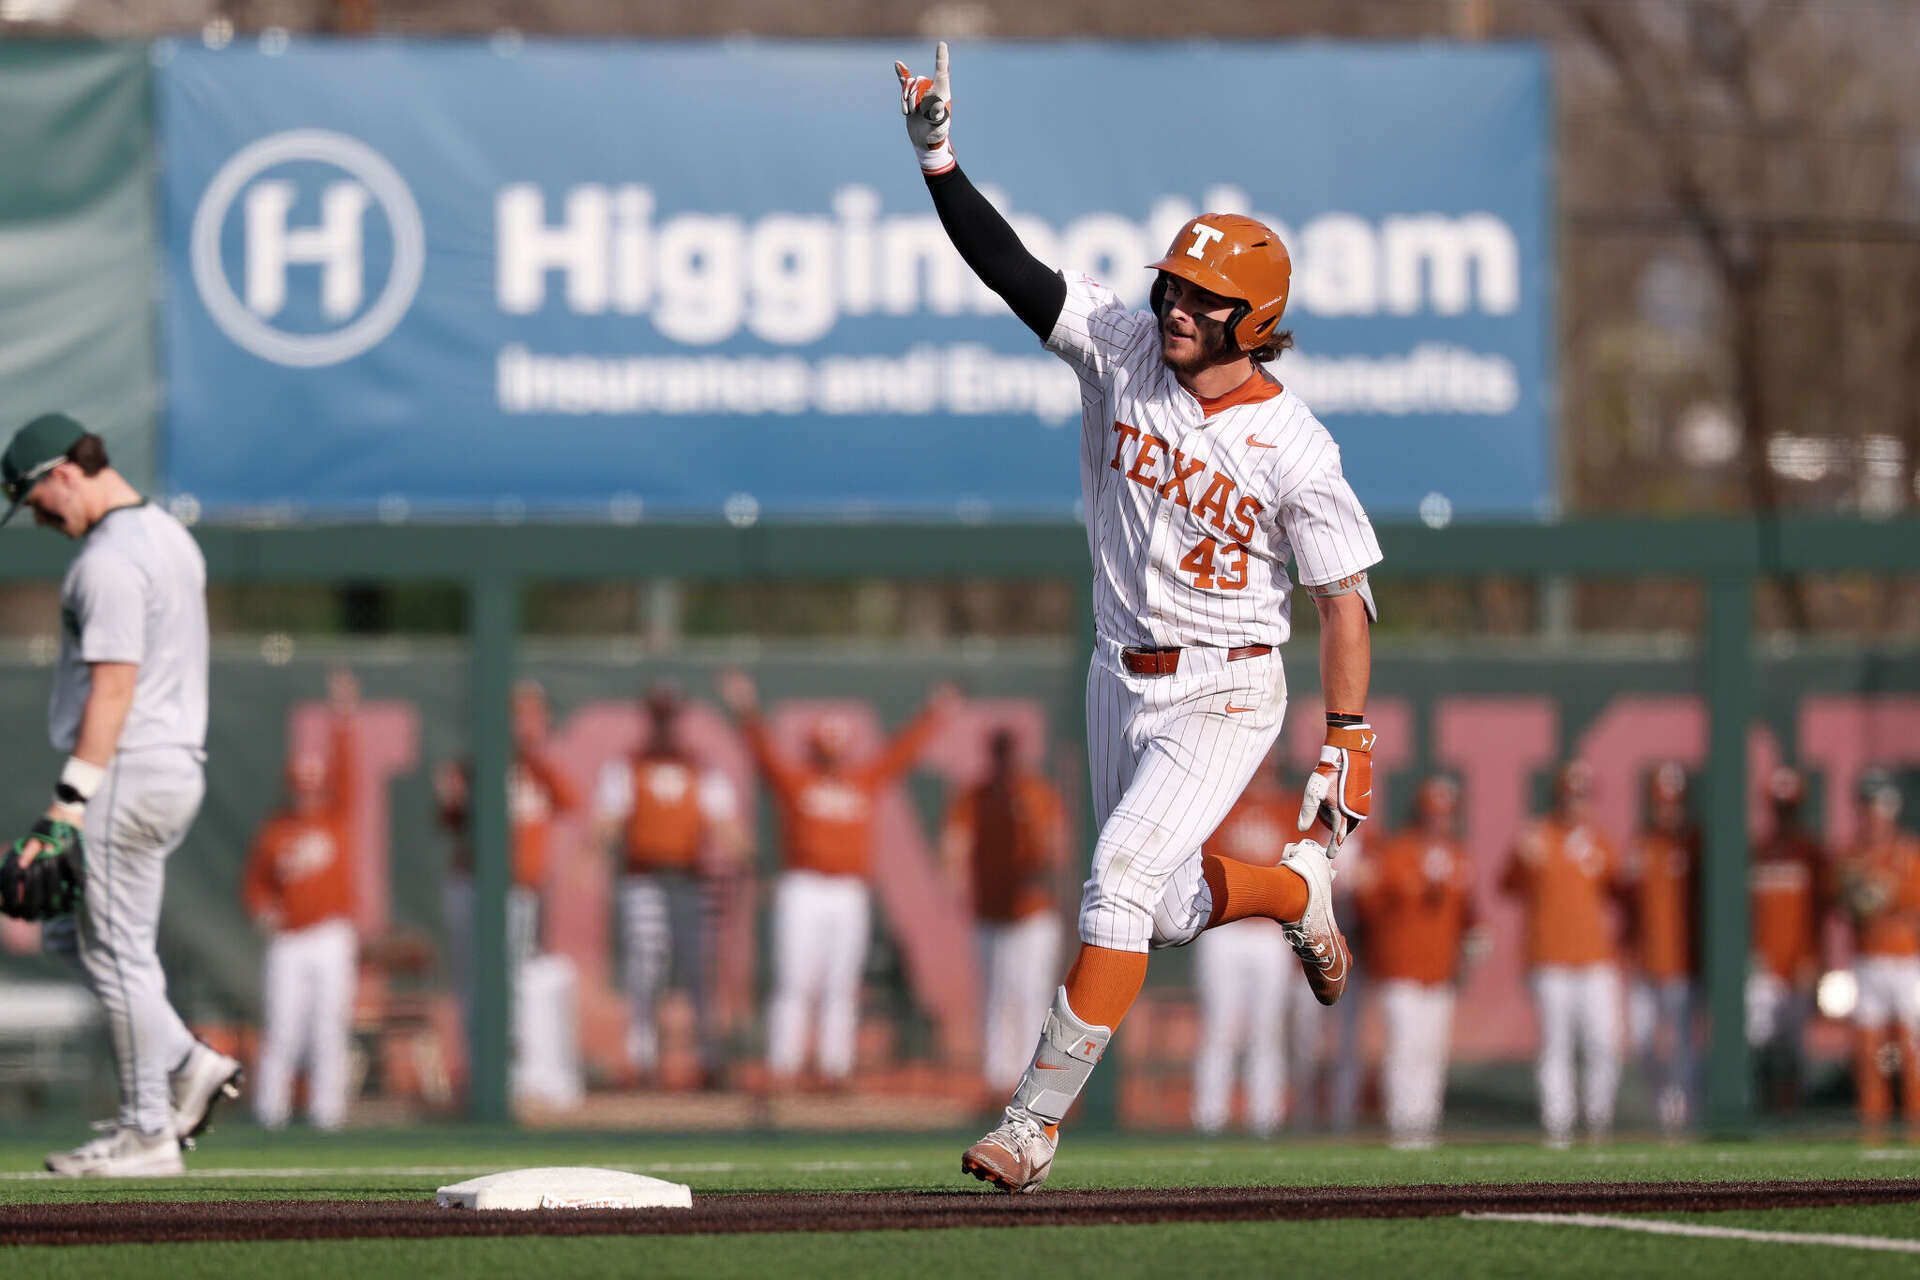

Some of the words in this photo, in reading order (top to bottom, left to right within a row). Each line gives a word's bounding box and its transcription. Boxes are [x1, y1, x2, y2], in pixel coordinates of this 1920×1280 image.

[246, 181, 364, 319] H
[1186, 222, 1224, 261] T
[499, 345, 809, 415] Insurance
[814, 345, 936, 415] and
[1110, 420, 1263, 544] TEXAS
[1179, 538, 1249, 590] 43
[1084, 1041, 1096, 1056] T
